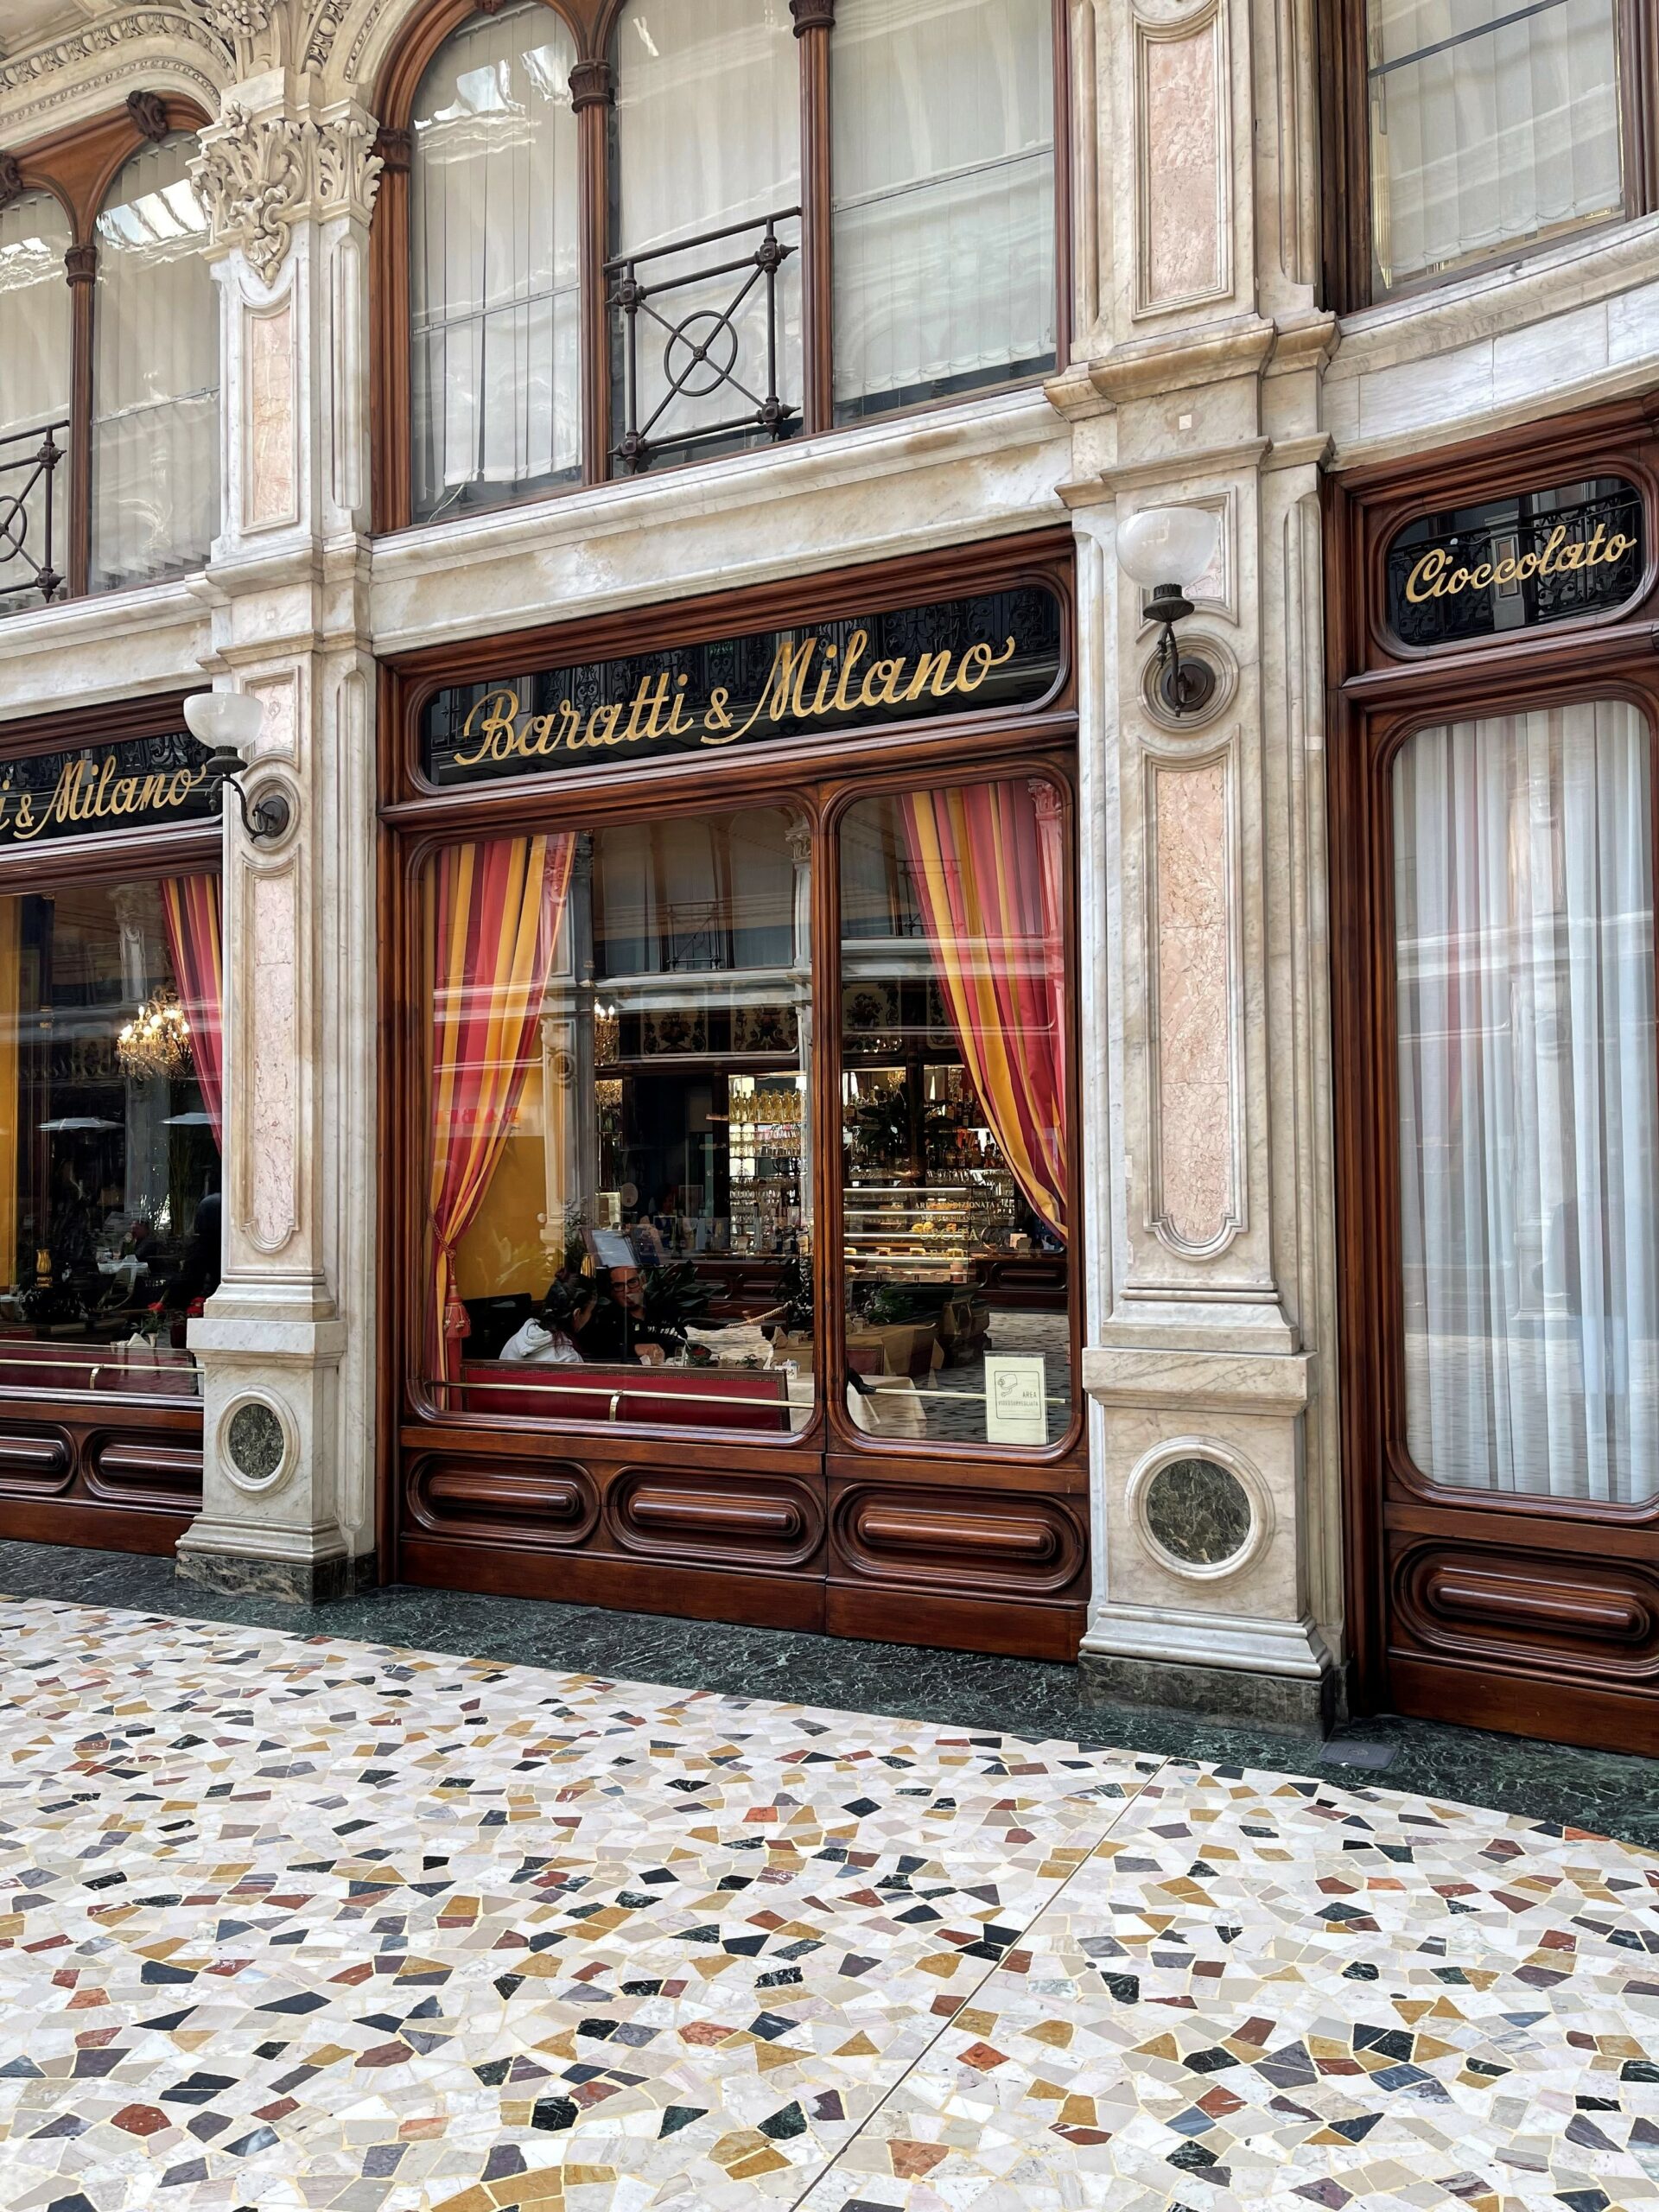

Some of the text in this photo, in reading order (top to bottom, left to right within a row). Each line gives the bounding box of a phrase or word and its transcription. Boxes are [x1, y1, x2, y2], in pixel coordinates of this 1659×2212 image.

[1406, 523, 1637, 603] Cioccolato
[454, 629, 1015, 766] Baratti & Milano
[13, 754, 207, 839] Milano
[15, 793, 35, 828] &
[919, 1227, 979, 1241] USCITA
[938, 1201, 995, 1210] ONDIZIONATA
